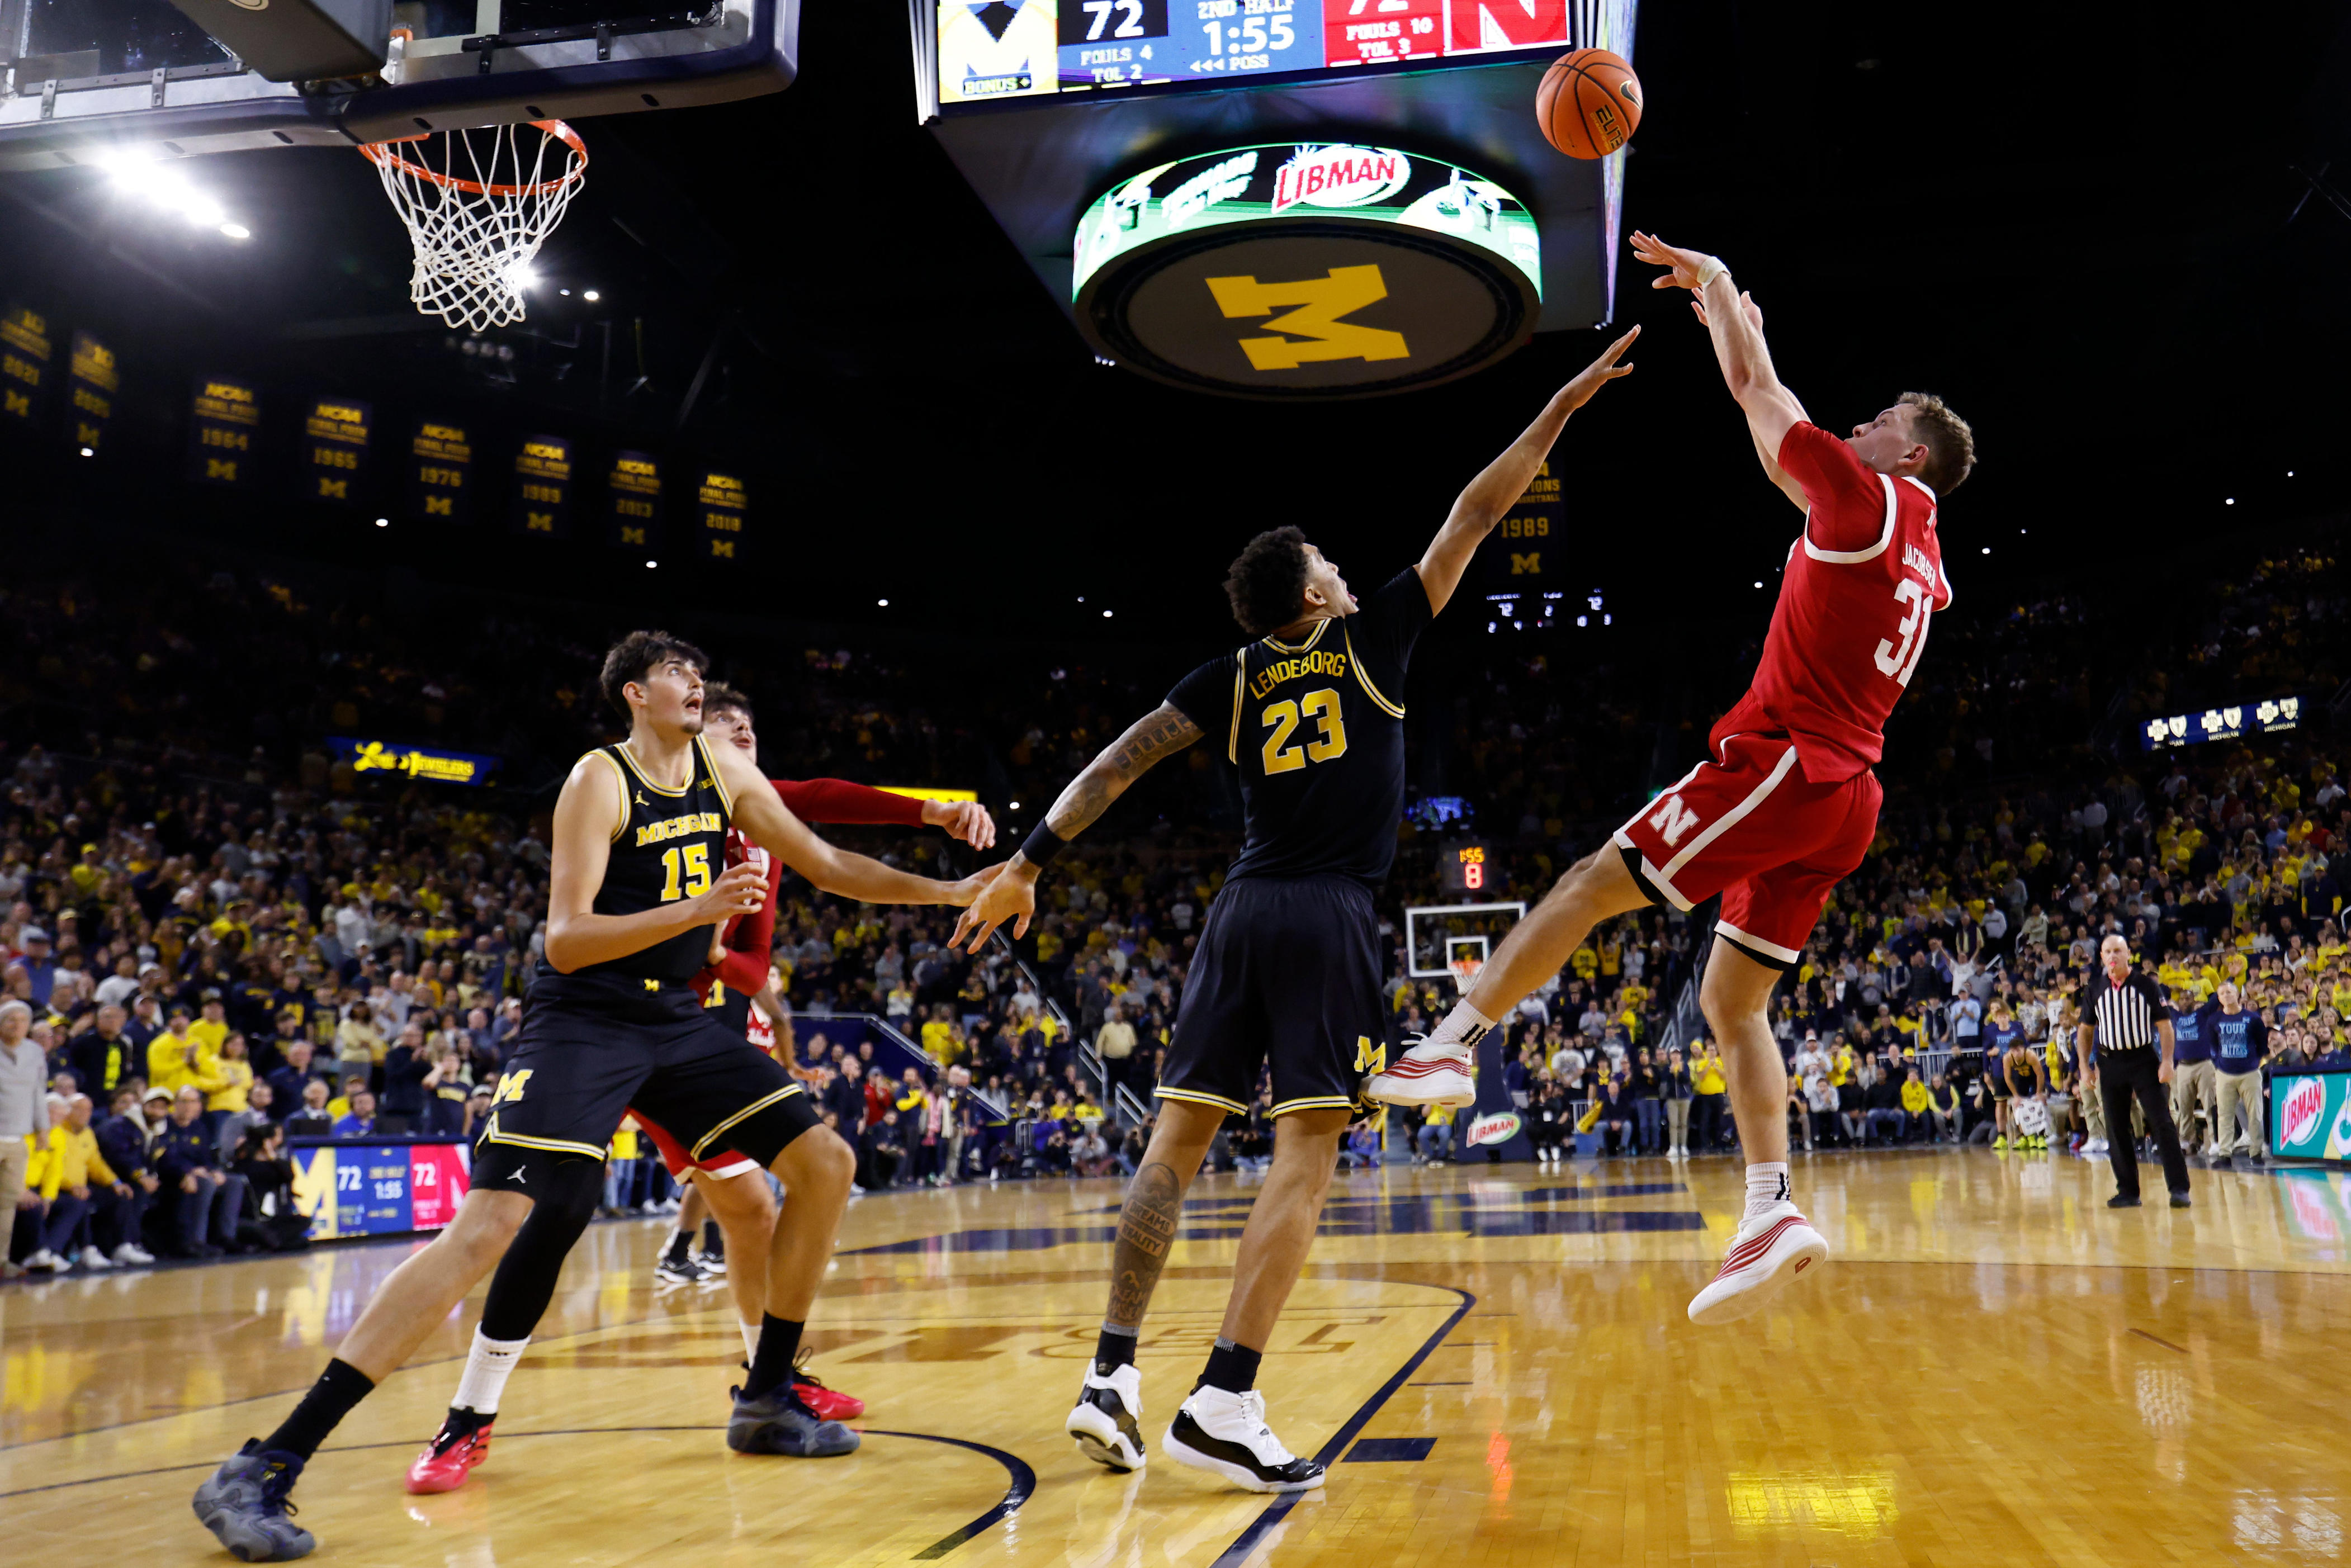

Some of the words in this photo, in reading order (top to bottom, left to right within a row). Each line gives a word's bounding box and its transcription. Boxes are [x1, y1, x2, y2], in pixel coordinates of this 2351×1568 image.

[1083, 0, 1144, 41] 72
[1198, 2, 1237, 19] 2ND
[1203, 14, 1295, 55] 1:55
[1410, 17, 1434, 35] 10
[1139, 44, 1153, 60] 4
[1398, 38, 1411, 54] 3
[1130, 64, 1143, 80] 2
[1229, 54, 1270, 70] POSS
[964, 78, 1018, 94] BONUS
[1275, 155, 1397, 210] LIBMAN
[1205, 264, 1410, 371] M
[1502, 517, 1549, 538] 1989
[1511, 552, 1541, 575] M
[1902, 542, 1936, 592] JACOBSEN
[1873, 577, 1934, 688] 31
[1248, 650, 1346, 700] LENDEBORG
[1261, 688, 1347, 775] 23
[2208, 731, 2240, 742] MICHIGAN
[2264, 722, 2296, 733] MICHIGAN
[1649, 793, 1701, 849] N
[660, 842, 712, 902] 15
[1464, 862, 1483, 889] 8
[2218, 1022, 2246, 1034] YOUR
[1354, 1035, 1387, 1074] M
[489, 1068, 534, 1108] M
[2281, 1081, 2322, 1147] LIBMAN
[1467, 1119, 1515, 1144] LIBMAN
[337, 1165, 363, 1191] 72
[413, 1162, 437, 1187] 72
